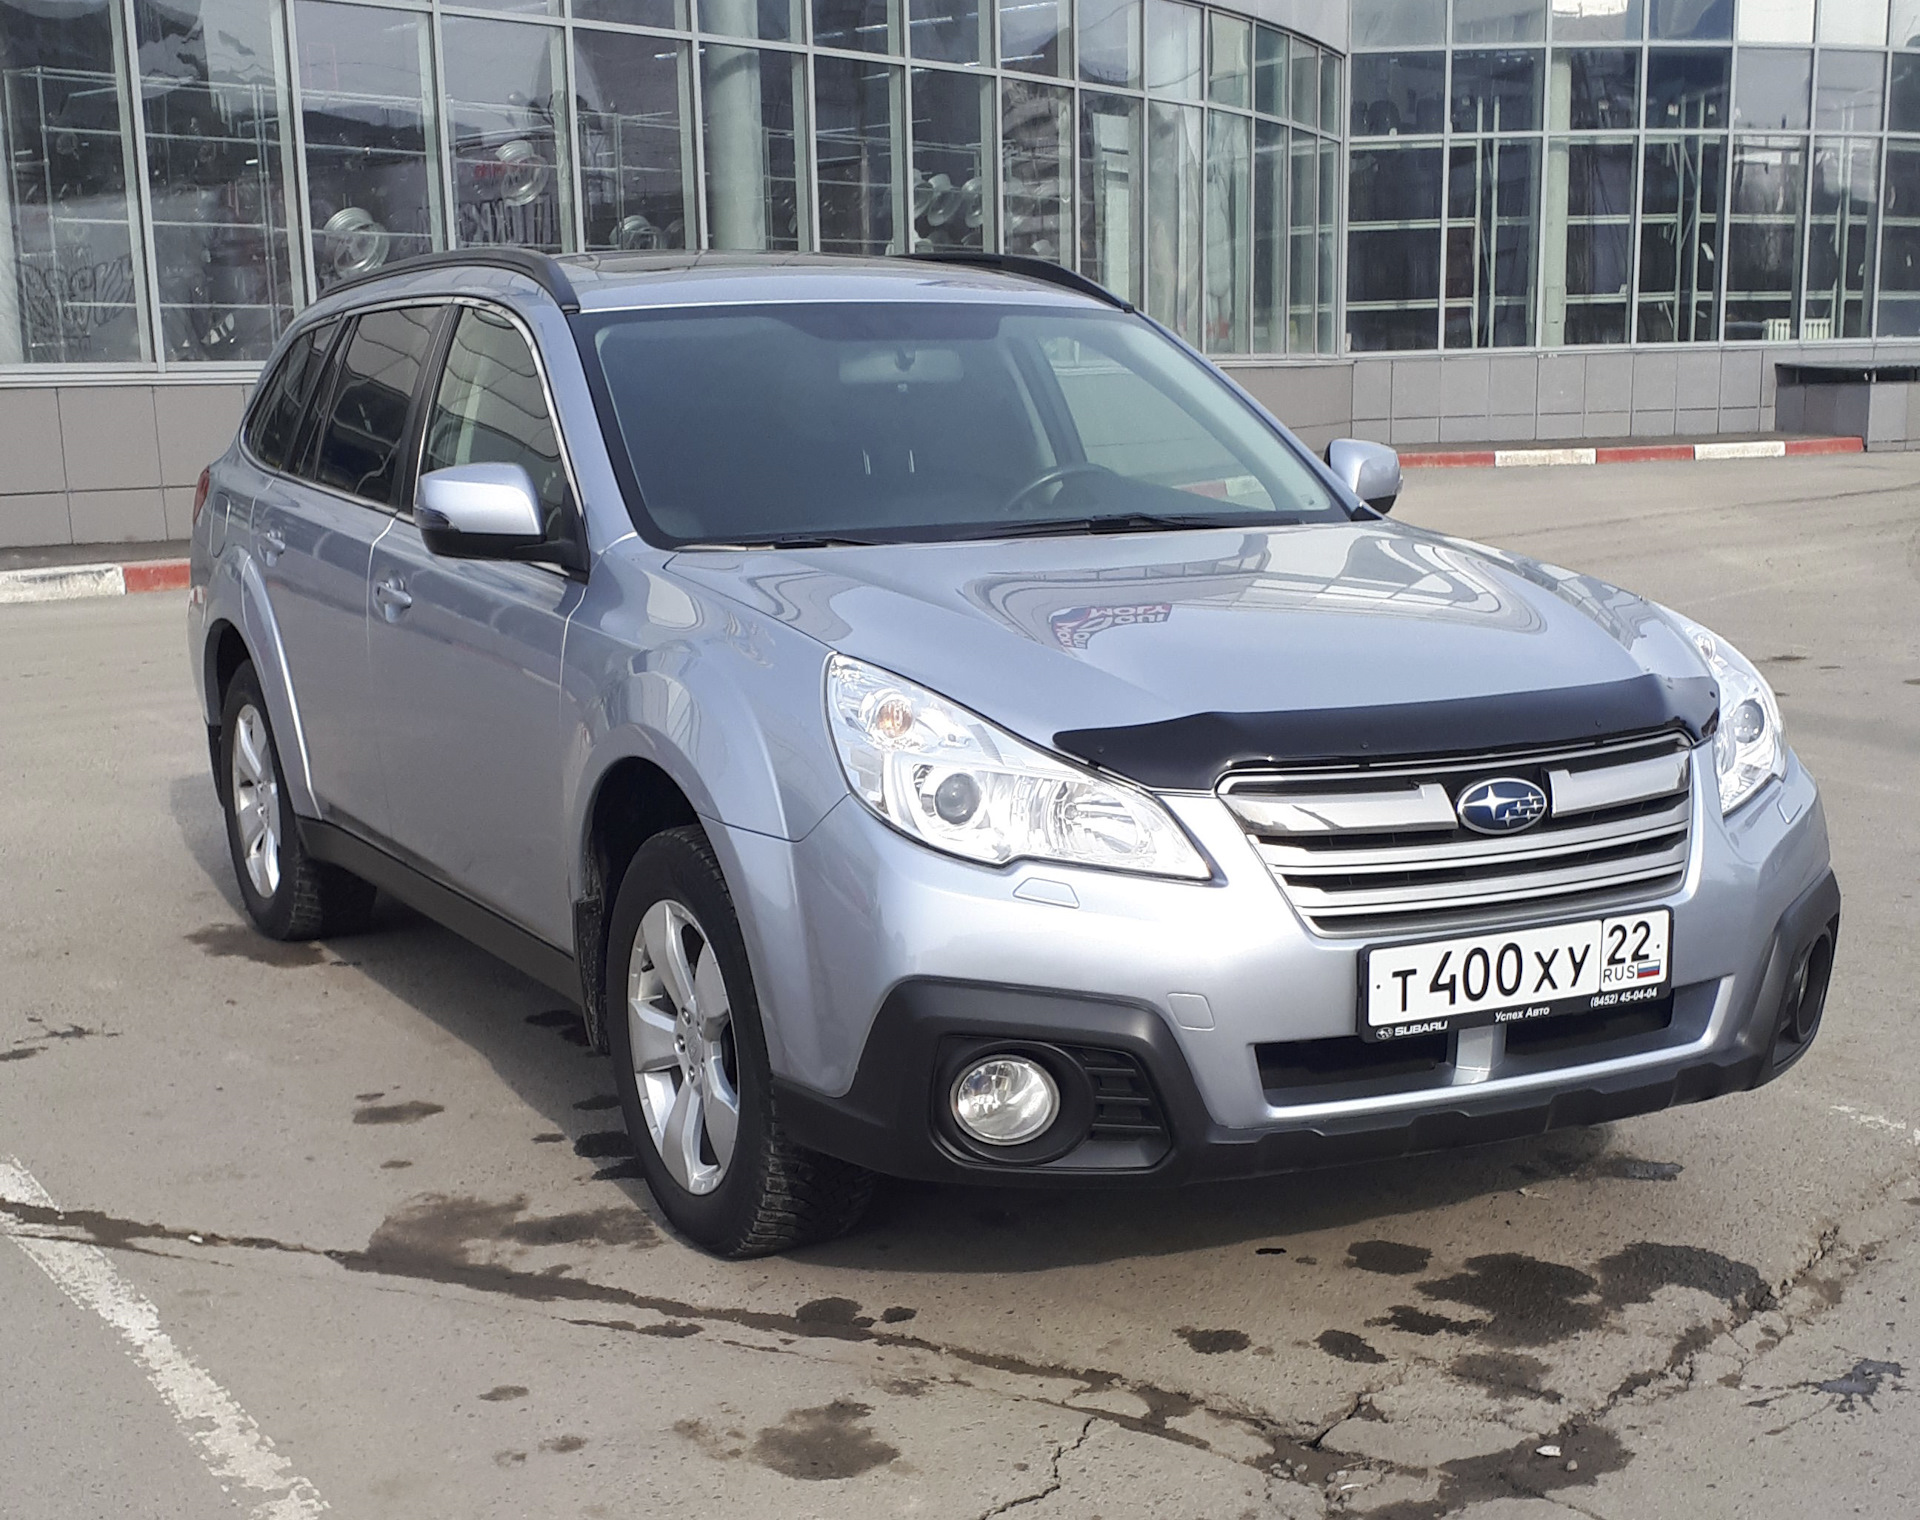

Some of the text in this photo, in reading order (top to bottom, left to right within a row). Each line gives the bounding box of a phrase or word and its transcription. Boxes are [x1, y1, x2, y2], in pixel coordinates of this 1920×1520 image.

[1607, 920, 1651, 966] 22
[1603, 965, 1635, 983] RUS
[1590, 987, 1657, 1008] (8452) 45-04-04
[1495, 1006, 1550, 1023] Успех Авто
[1394, 1020, 1448, 1037] SUBARU
